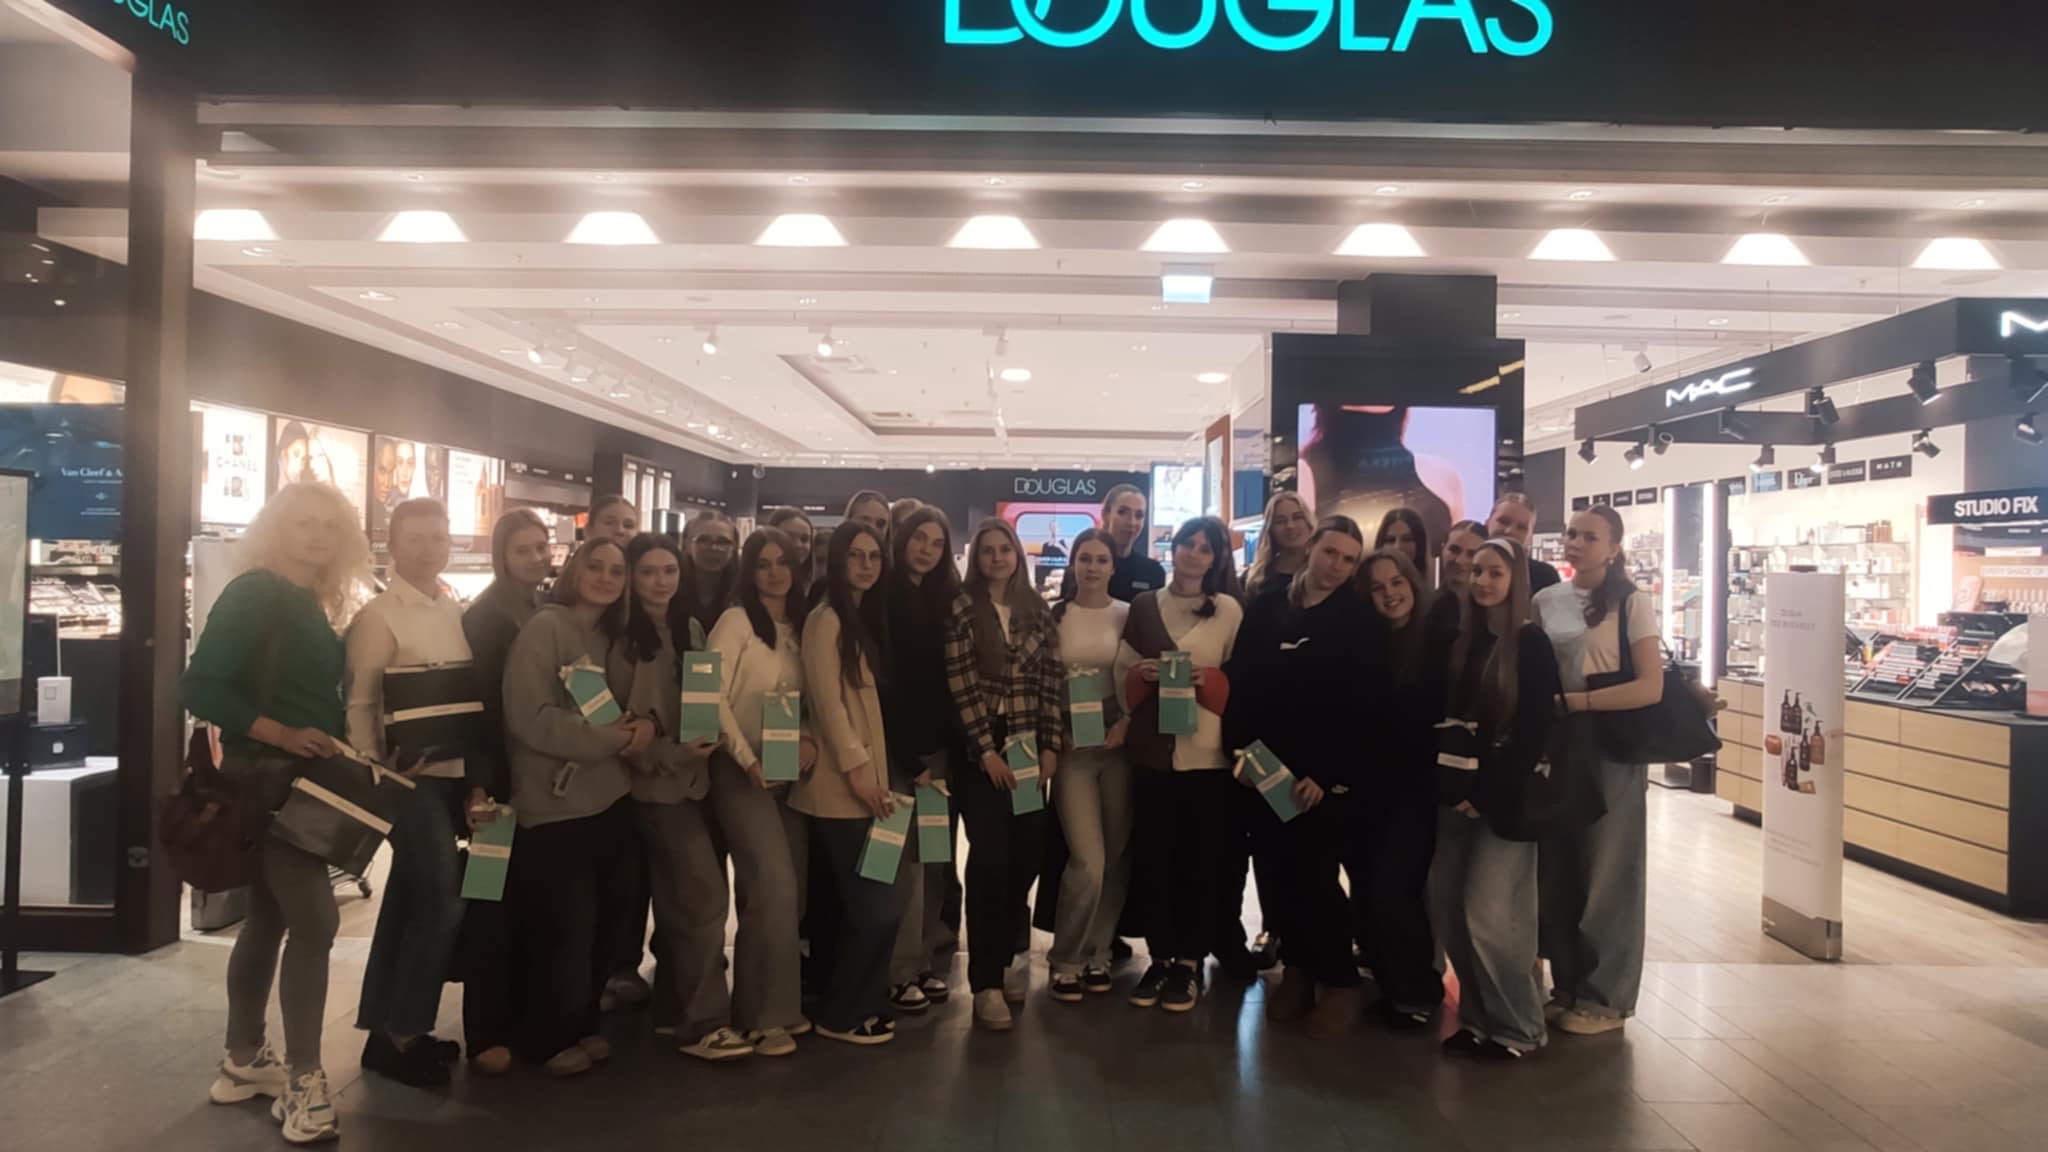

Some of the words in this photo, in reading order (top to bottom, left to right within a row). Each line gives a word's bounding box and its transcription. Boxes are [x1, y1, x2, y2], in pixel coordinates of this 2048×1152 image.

[112, 0, 190, 45] GLAS
[1665, 366, 1755, 408] MAC
[1014, 477, 1097, 496] DOUGLAS
[1953, 497, 2011, 518] STUDIO
[2012, 495, 2040, 515] FIX
